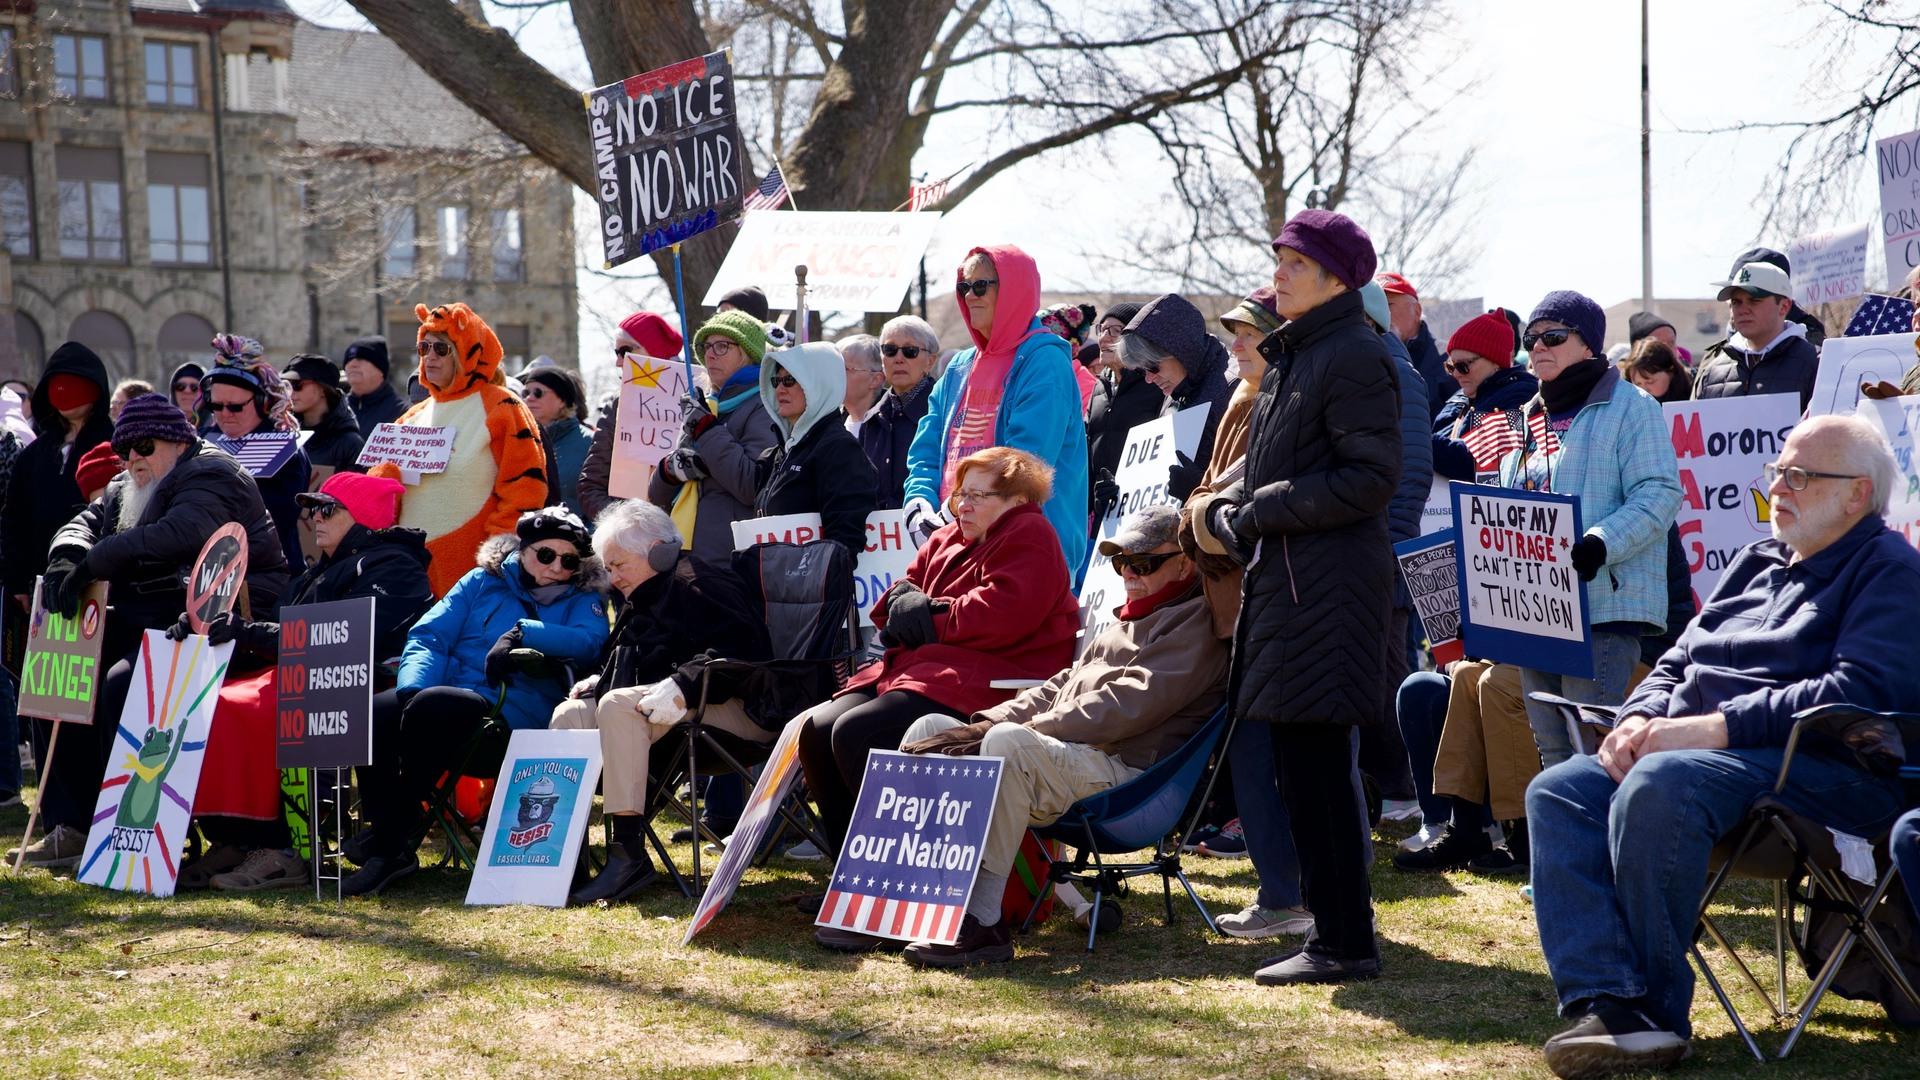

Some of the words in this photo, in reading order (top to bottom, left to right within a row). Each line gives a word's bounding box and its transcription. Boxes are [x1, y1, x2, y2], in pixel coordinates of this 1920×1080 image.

[615, 95, 658, 146] NO
[674, 75, 724, 129] ICE
[590, 95, 620, 203] CAMPS
[675, 133, 738, 210] WAR
[604, 214, 625, 260] NO
[823, 221, 902, 238] AMERICA
[1807, 283, 1820, 303] NO
[1824, 275, 1860, 298] KINGS
[371, 435, 397, 445] HAVE
[400, 437, 413, 446] TO
[415, 439, 446, 448] DEFEND
[380, 423, 395, 434] WE
[620, 426, 632, 442] in
[359, 454, 382, 464] FROM
[406, 460, 446, 471] PRESIDENT
[367, 444, 430, 459] DEMOCRACY
[1125, 433, 1165, 469] DUE
[1679, 468, 1742, 512] Are
[1470, 496, 1505, 528] ALL
[1507, 504, 1526, 531] OF
[1530, 506, 1558, 537] MY
[1479, 527, 1557, 563] OUTRAGE
[199, 551, 236, 597] WAR
[1403, 561, 1417, 574] WE
[1416, 554, 1426, 565] THE
[1427, 547, 1453, 561] PEOPLE
[1473, 554, 1510, 577] CAN'T
[1514, 562, 1543, 586] FIT
[1550, 566, 1572, 593] ON
[1433, 564, 1459, 590] KIN
[1417, 595, 1440, 617] NO
[1438, 589, 1460, 612] WA
[1480, 582, 1531, 622] THIS
[1532, 591, 1574, 633] SIGN
[281, 618, 306, 650] NO
[309, 619, 350, 647] KINGS
[1426, 612, 1458, 641] NO
[22, 650, 95, 702] KINGS
[280, 663, 305, 694] NO
[309, 663, 368, 691] FASCISTS
[279, 709, 305, 739] NO
[308, 710, 349, 737] NAZIS
[513, 763, 541, 785] ONLY
[543, 761, 562, 774] YOU
[563, 765, 580, 784] CAN
[875, 786, 935, 831] Pray
[935, 791, 972, 826] for
[107, 826, 155, 854] RESIST
[508, 823, 552, 845] RESIST
[496, 854, 525, 864] FASCIST
[527, 854, 551, 864] LIARS
[849, 834, 896, 863] our
[896, 832, 976, 872] Nation
